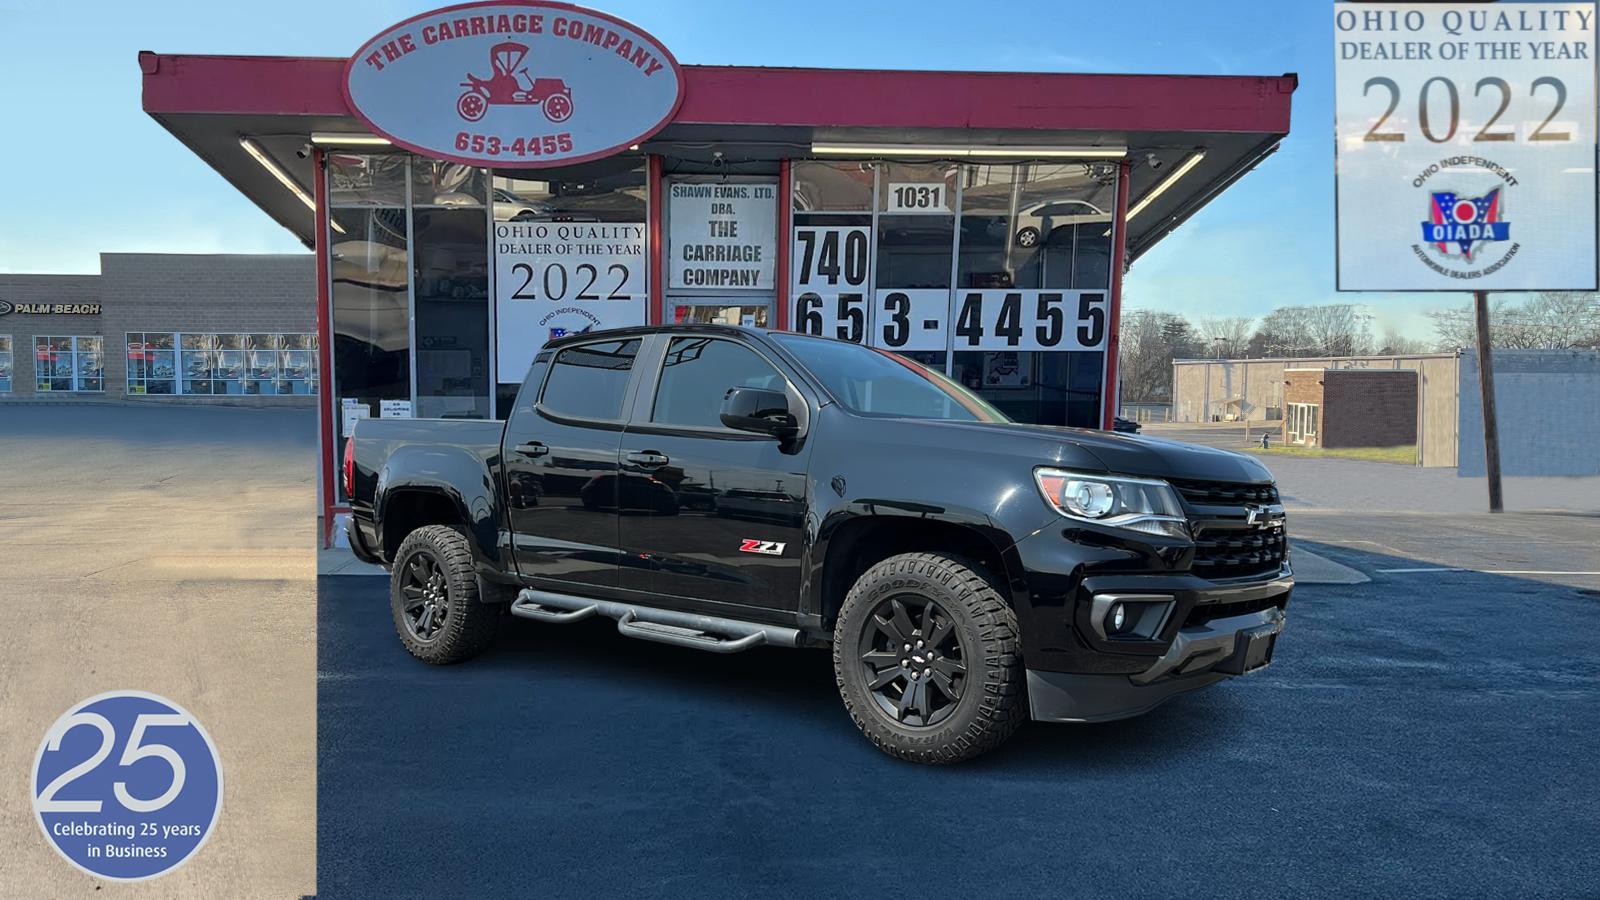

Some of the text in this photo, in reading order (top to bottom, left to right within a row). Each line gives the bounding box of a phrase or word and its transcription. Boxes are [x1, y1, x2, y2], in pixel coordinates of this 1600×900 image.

[1337, 10, 1592, 34] OHIO QUALITY
[366, 14, 664, 77] THE CARRIAGE COMPANY
[1340, 42, 1588, 59] DEALER OF THE YEAR
[1363, 76, 1570, 142] 2022
[455, 133, 573, 157] 653-4455
[1413, 156, 1519, 188] OHIO INDEPENDENT
[673, 184, 713, 199] SHAWN
[754, 186, 774, 199] LTD.
[894, 186, 940, 209] 1031
[711, 204, 735, 215] DBA.
[497, 226, 644, 240] OHIO QUALITY
[709, 221, 737, 238] THE
[1433, 224, 1494, 240] OIADA
[499, 243, 641, 255] DEALER OF THE YEAR
[683, 245, 762, 262] CARRIAGE
[798, 230, 867, 286] 740
[1411, 242, 1520, 280] AUTOMOBILE DEALERS ASSOCIATION
[511, 263, 631, 301] 2022
[683, 269, 760, 286] COMPANY
[15, 304, 50, 314] PALM
[55, 304, 100, 314] BEACH
[539, 307, 601, 326] OHIO INDEPENDENT
[739, 539, 787, 555] Z71
